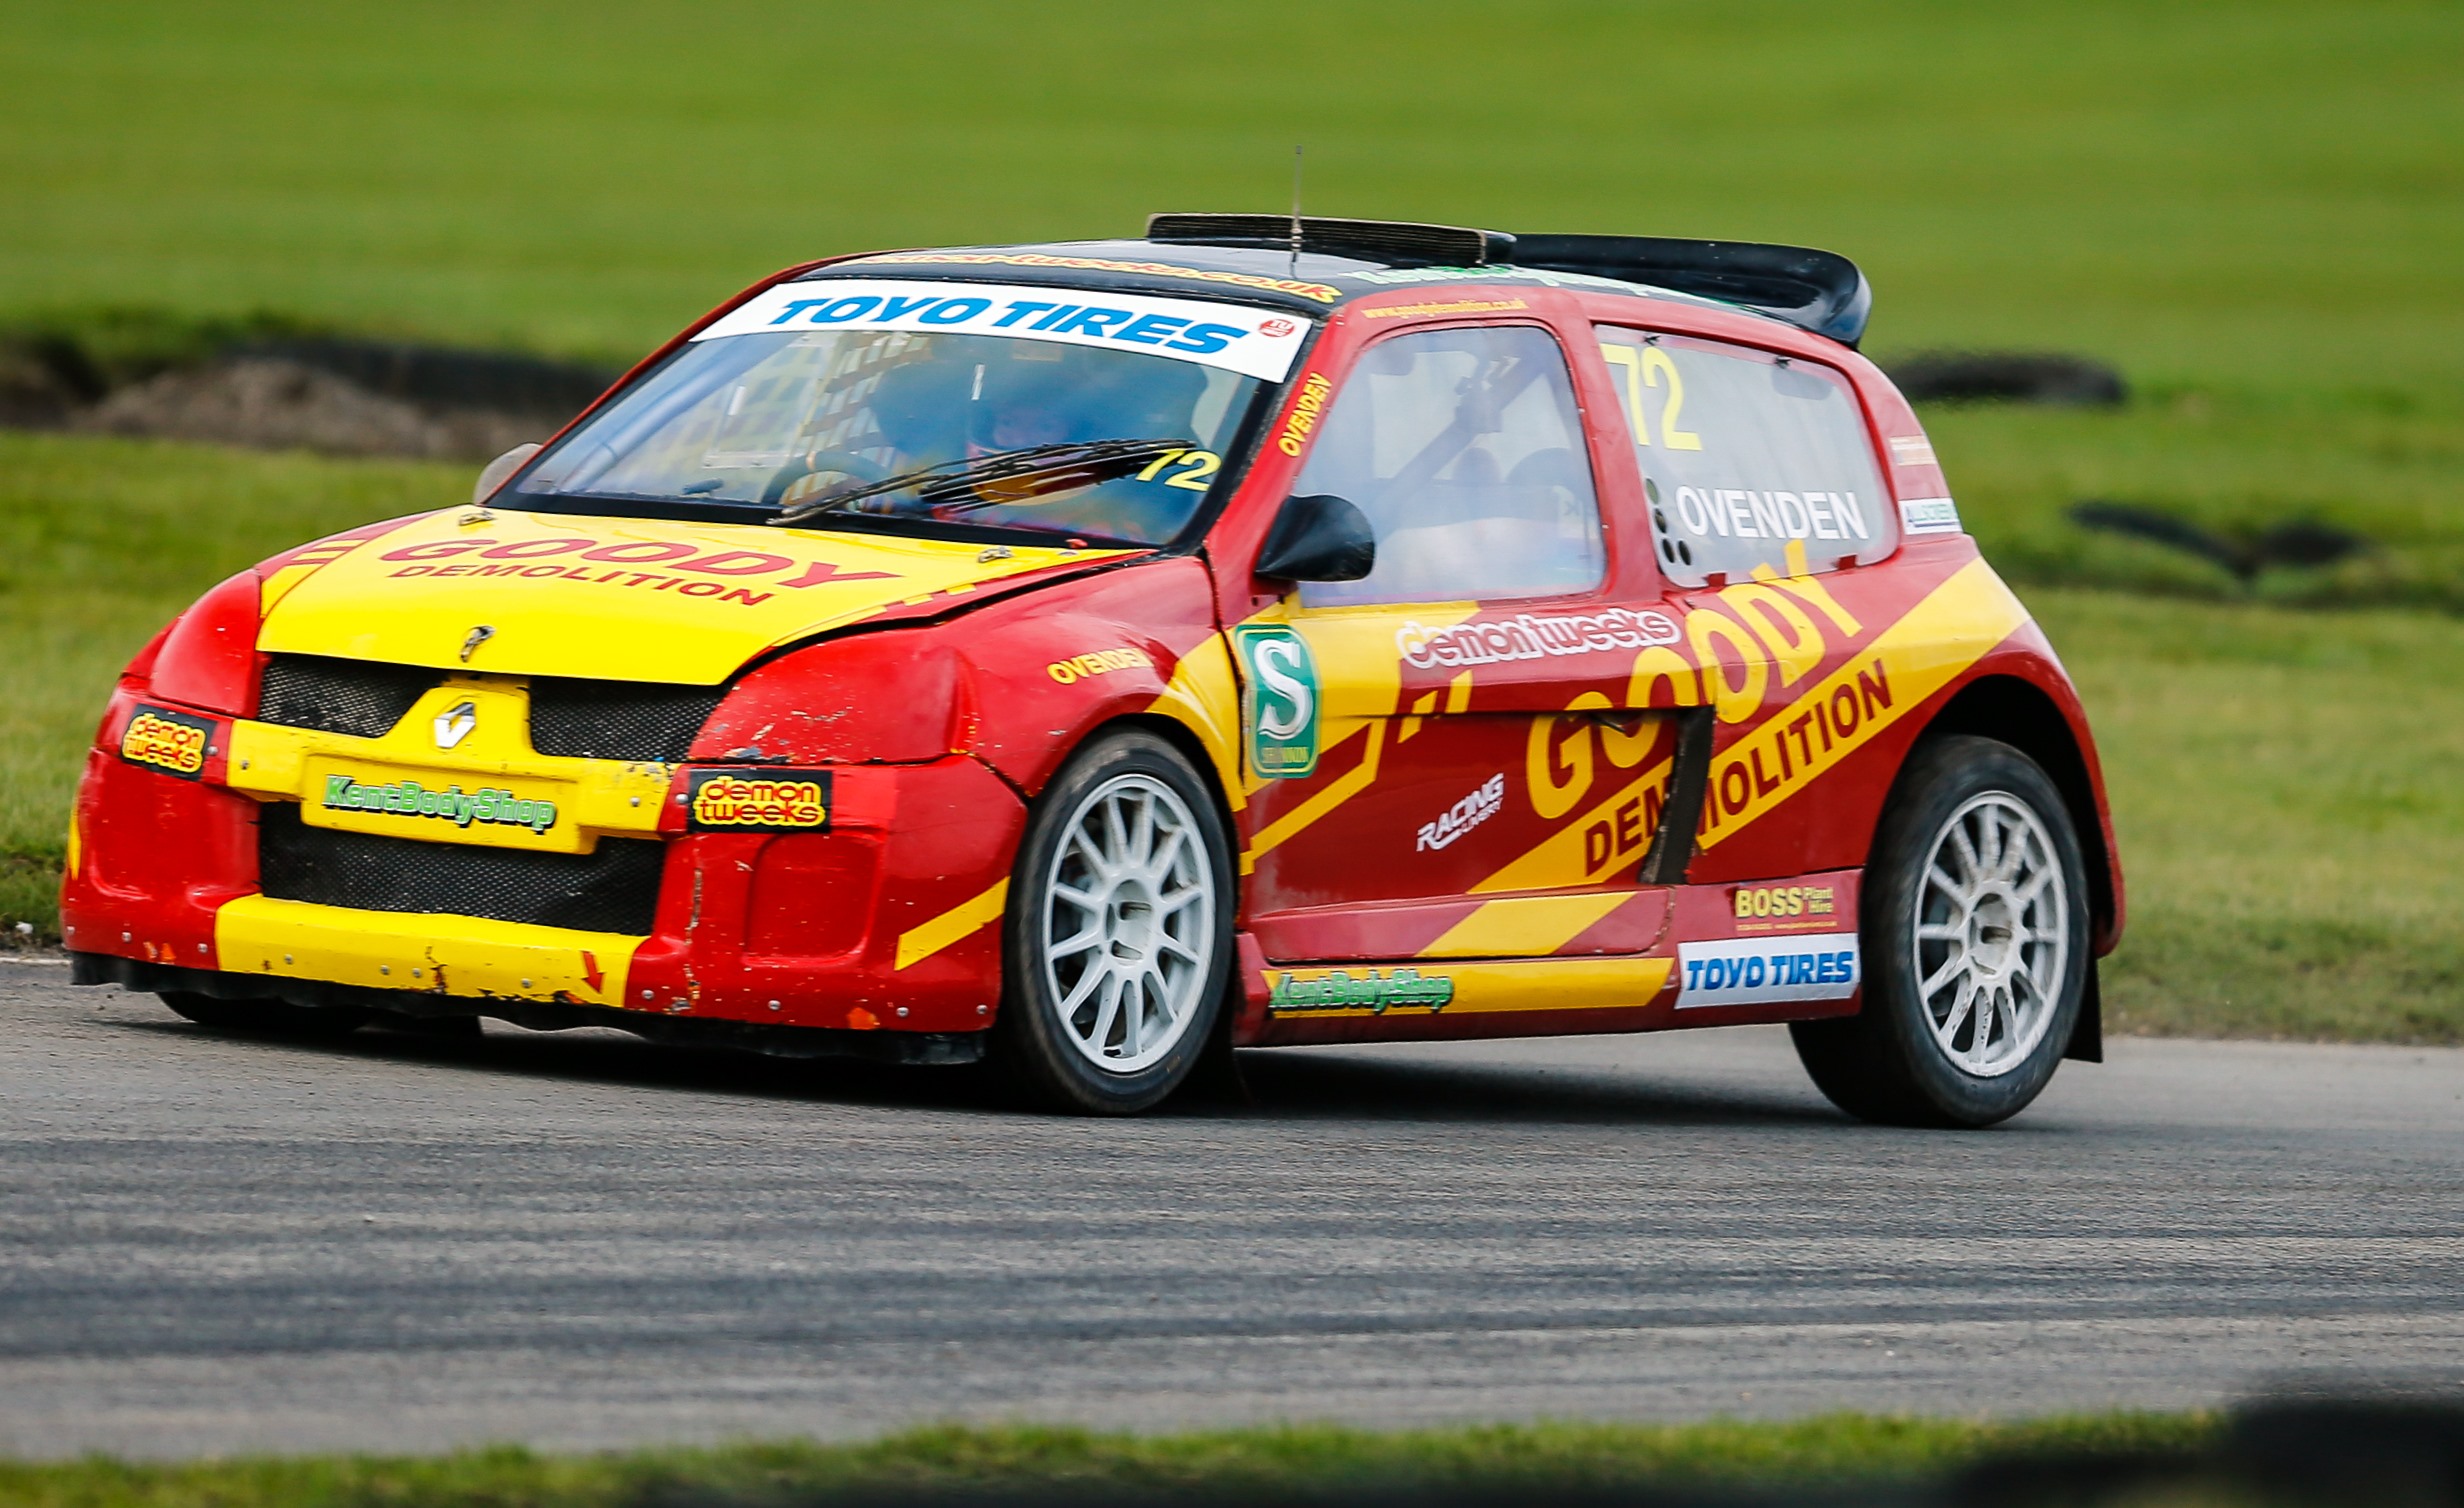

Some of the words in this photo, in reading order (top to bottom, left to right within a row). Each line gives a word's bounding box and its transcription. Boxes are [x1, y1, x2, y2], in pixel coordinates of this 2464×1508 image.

[768, 295, 992, 325] TOYO
[993, 301, 1250, 354] TIRES
[1278, 372, 1332, 457] OVENDEN
[1599, 343, 1702, 451] 72
[1135, 448, 1222, 492] 72
[1676, 485, 1869, 539] OVENDEN
[379, 537, 906, 589] GOODY
[387, 564, 776, 606] DEMOLITION
[1526, 539, 1863, 819] GOODY
[122, 731, 203, 773] tweeks
[128, 712, 206, 752] demon
[697, 774, 822, 803] demon
[692, 796, 826, 826] tweeks
[1416, 772, 1504, 852] RACING
[1735, 886, 1804, 918] BOSS
[1687, 956, 1765, 991] TOYO
[1770, 951, 1854, 986] TIRES
